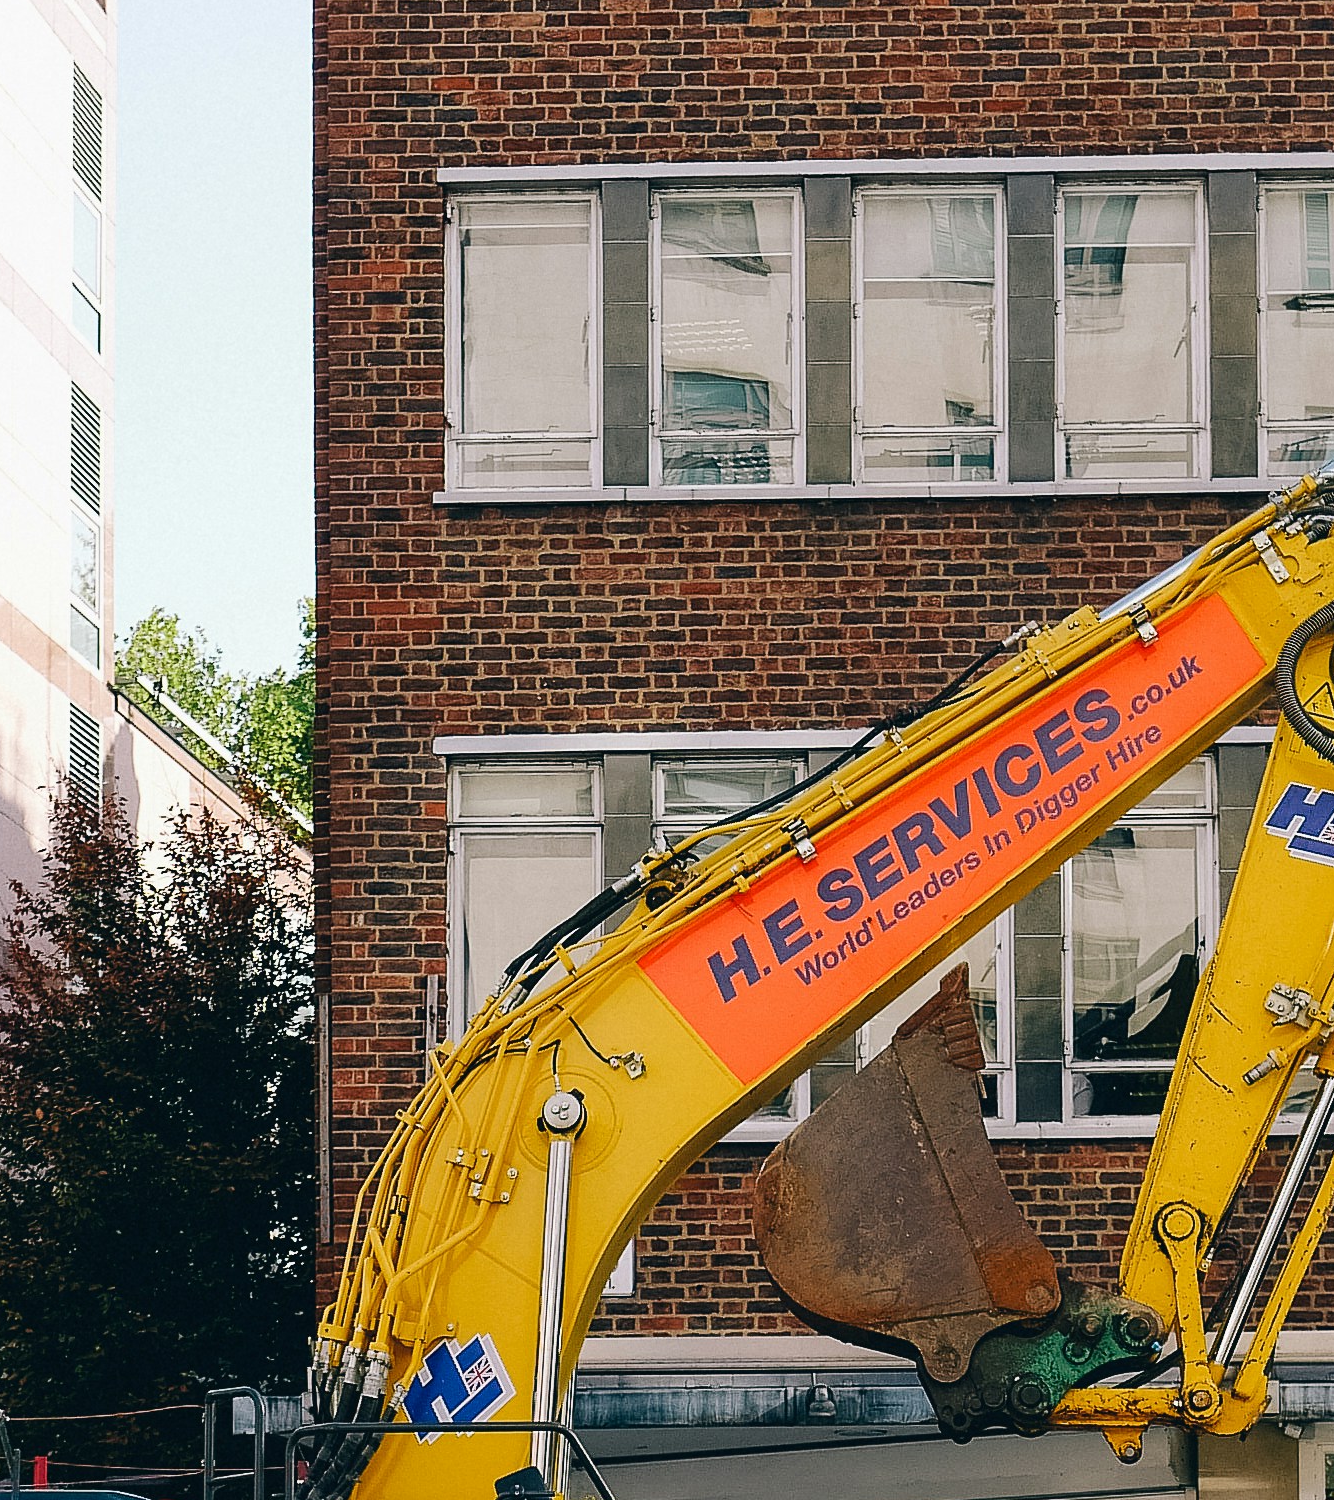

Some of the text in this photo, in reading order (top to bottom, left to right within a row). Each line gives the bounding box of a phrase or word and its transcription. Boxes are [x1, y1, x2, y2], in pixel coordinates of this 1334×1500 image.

[794, 725, 1162, 986] World Leaders In Digger Hire
